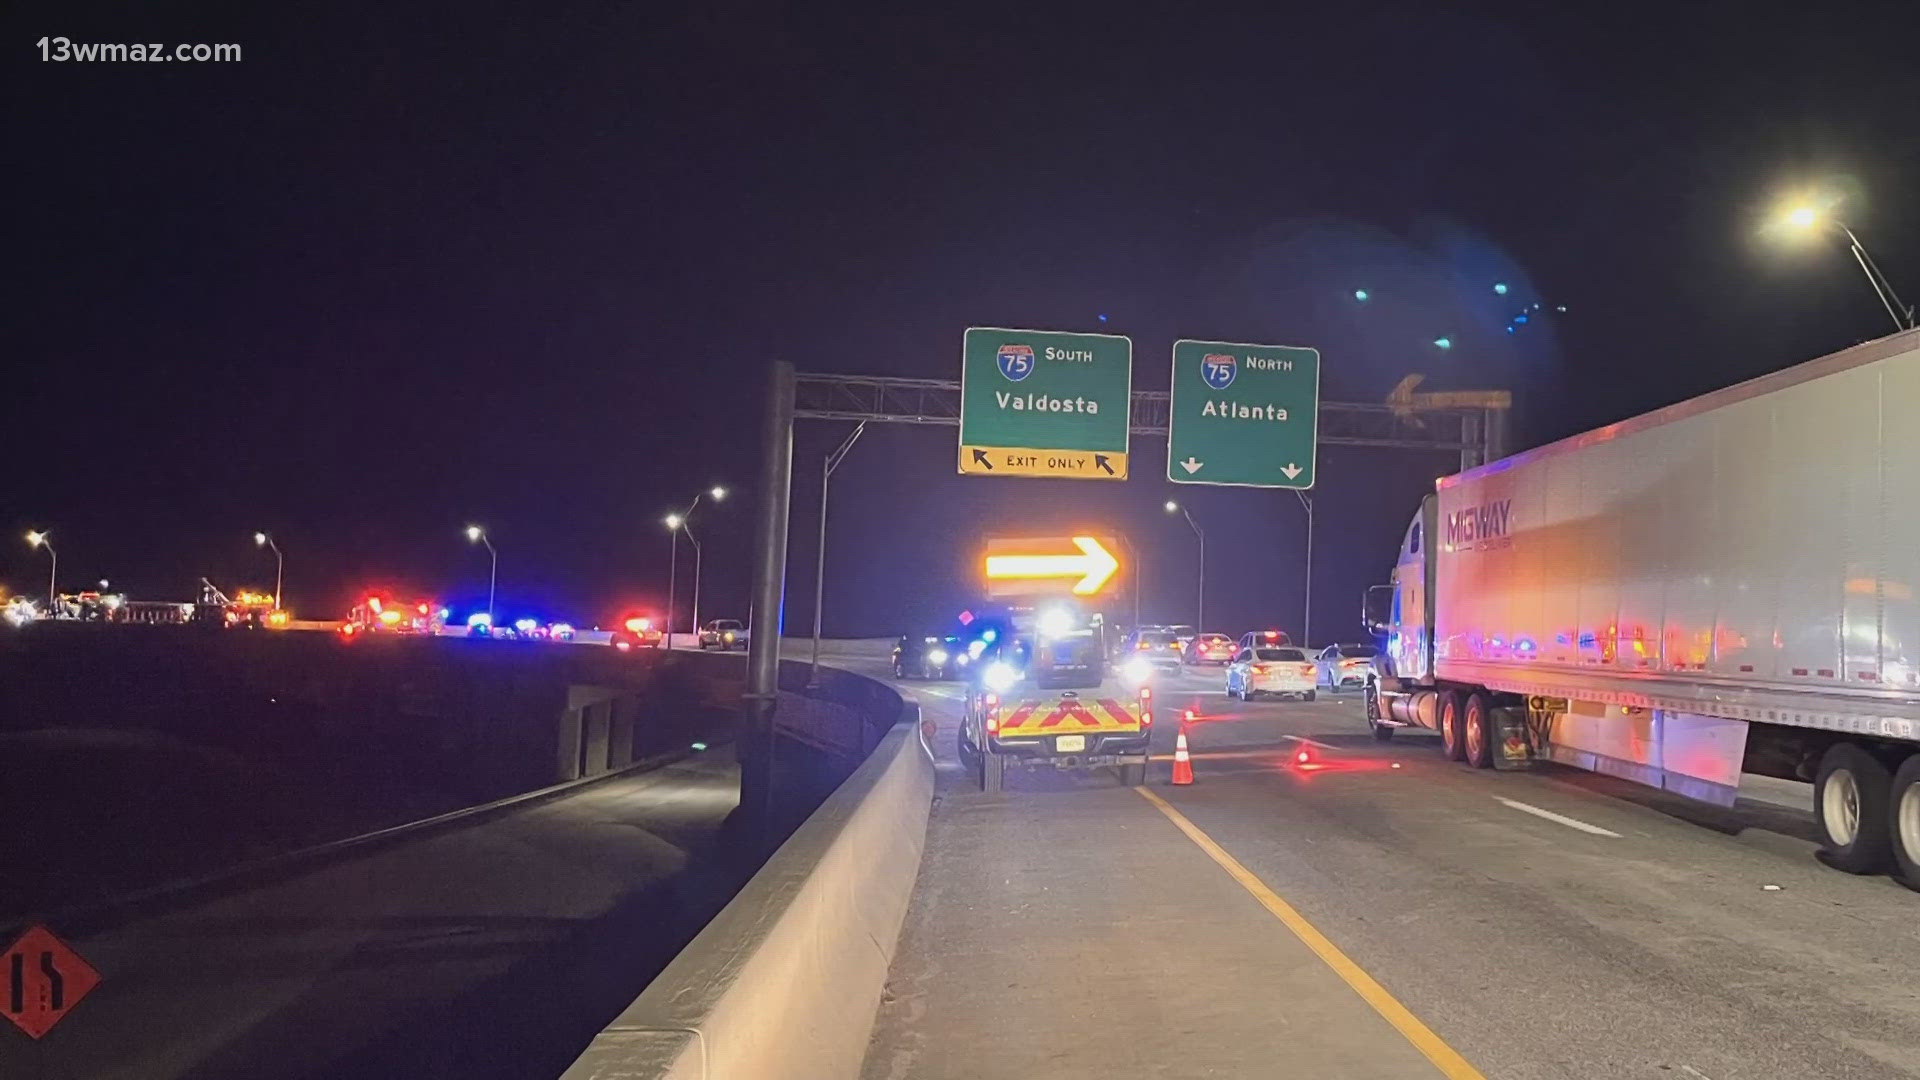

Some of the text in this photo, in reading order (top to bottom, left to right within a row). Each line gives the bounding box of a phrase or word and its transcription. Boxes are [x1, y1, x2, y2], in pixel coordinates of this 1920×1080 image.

[1004, 355, 1027, 372] 75
[1045, 347, 1093, 362] SOUTH
[1208, 363, 1230, 381] 75
[1246, 355, 1292, 371] NORTH
[996, 391, 1098, 414] Valdosta
[1202, 400, 1288, 421] Atlanta
[1007, 455, 1085, 469] EXIT ONLY
[1447, 499, 1512, 545] MIGWAY
